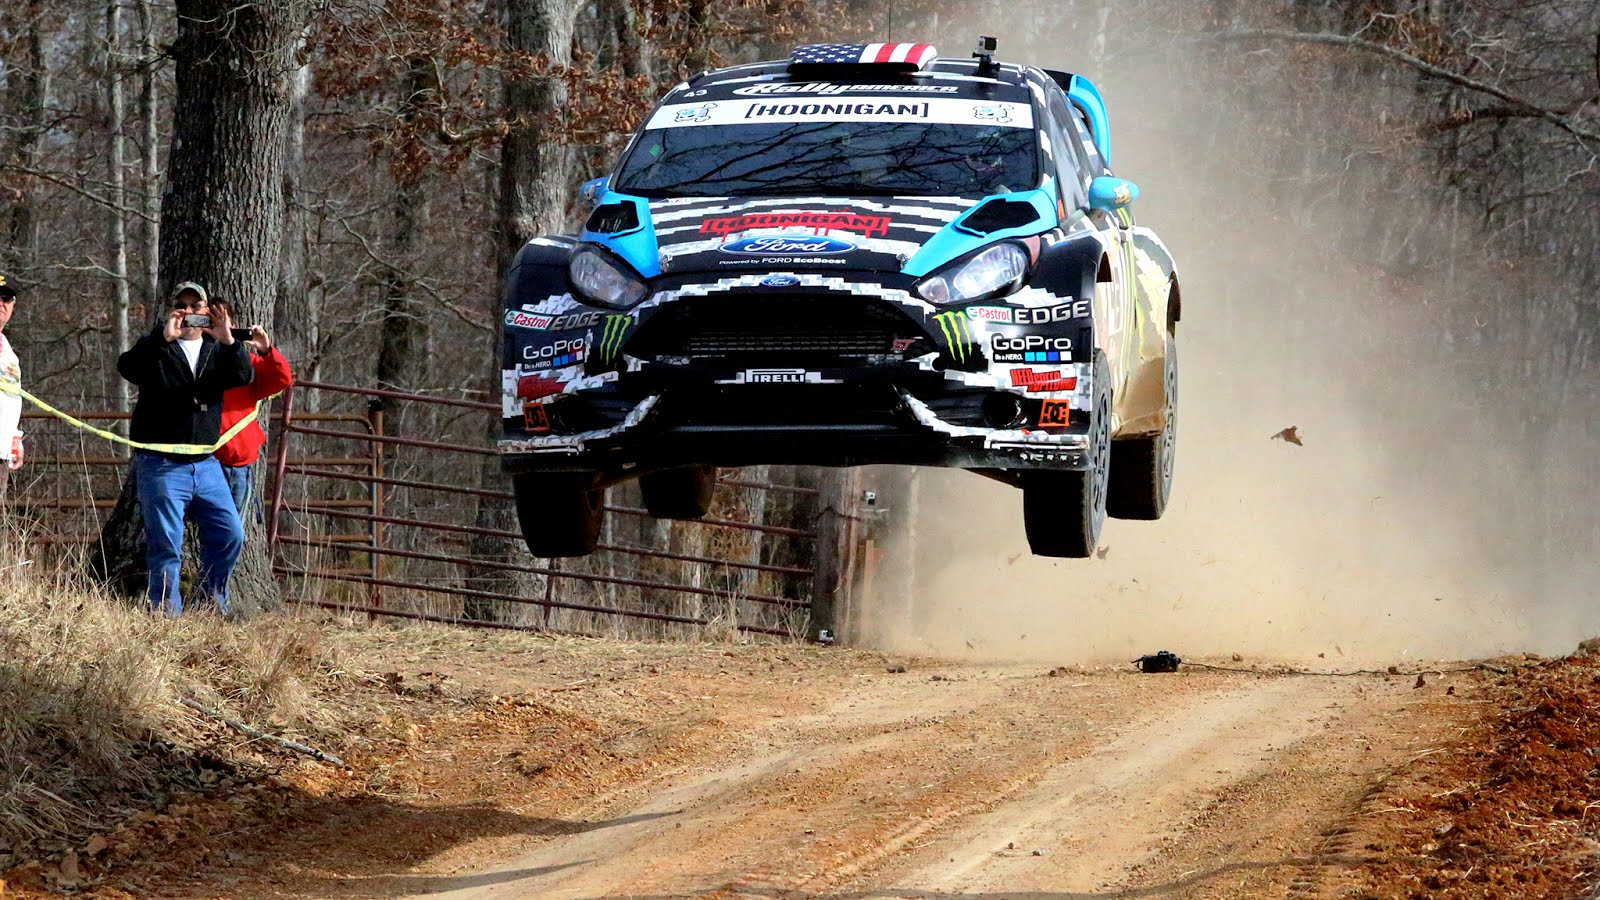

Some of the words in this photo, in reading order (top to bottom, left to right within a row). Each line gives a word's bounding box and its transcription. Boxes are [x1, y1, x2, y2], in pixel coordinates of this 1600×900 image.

[733, 82, 844, 95] Rally
[744, 103, 929, 119] [HOONIGAN]
[706, 214, 887, 232] [HOONIGAN]
[744, 237, 831, 252] Ford
[793, 257, 847, 265] EcoBoost
[978, 307, 1011, 321] Castrol
[1014, 300, 1090, 324] EDGE
[513, 312, 550, 328] Castrol
[550, 310, 606, 331] EDGE
[523, 338, 584, 360] GoPro
[993, 335, 1072, 351] GoPro
[745, 368, 806, 383] PIRELLI
[1010, 369, 1033, 386] NEED
[1042, 400, 1069, 424] DC
